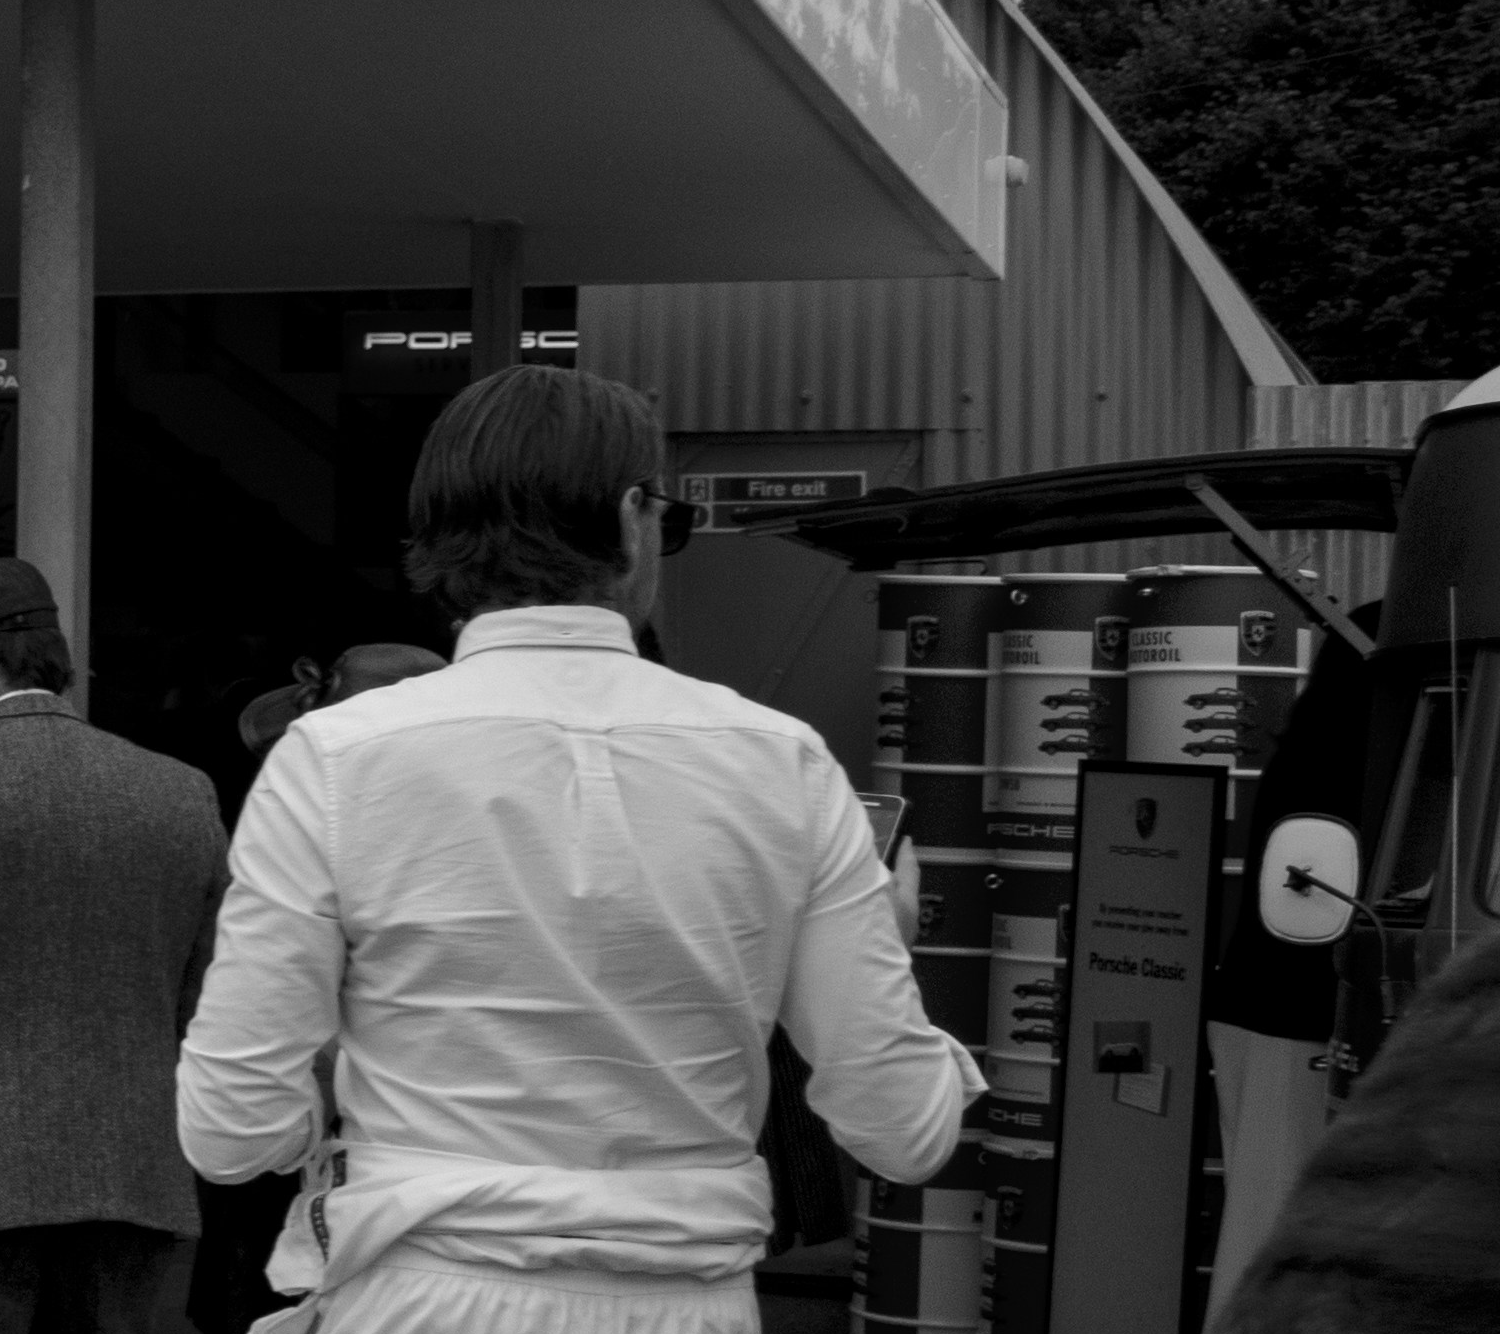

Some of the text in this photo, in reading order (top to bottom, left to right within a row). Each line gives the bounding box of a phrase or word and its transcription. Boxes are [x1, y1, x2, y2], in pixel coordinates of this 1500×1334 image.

[747, 481, 827, 497] Fire exit
[1089, 951, 1187, 981] Porsche Classic
